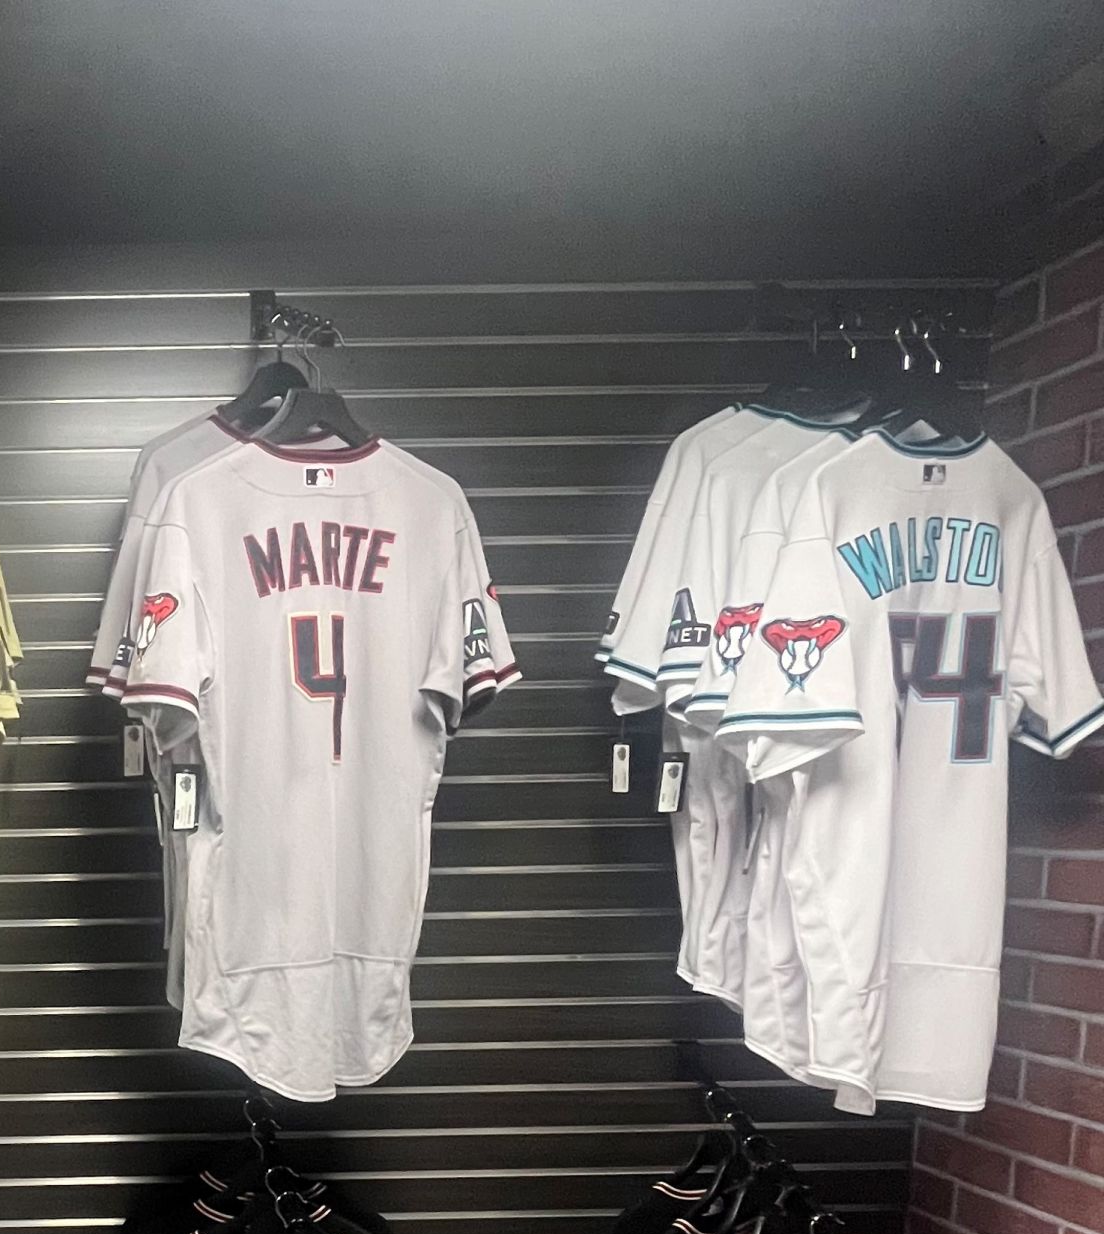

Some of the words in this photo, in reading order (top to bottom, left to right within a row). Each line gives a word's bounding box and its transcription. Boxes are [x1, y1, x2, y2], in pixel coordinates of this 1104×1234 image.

[243, 521, 396, 598] MARTE
[837, 517, 1004, 600] WALSTO
[287, 611, 346, 765] 4
